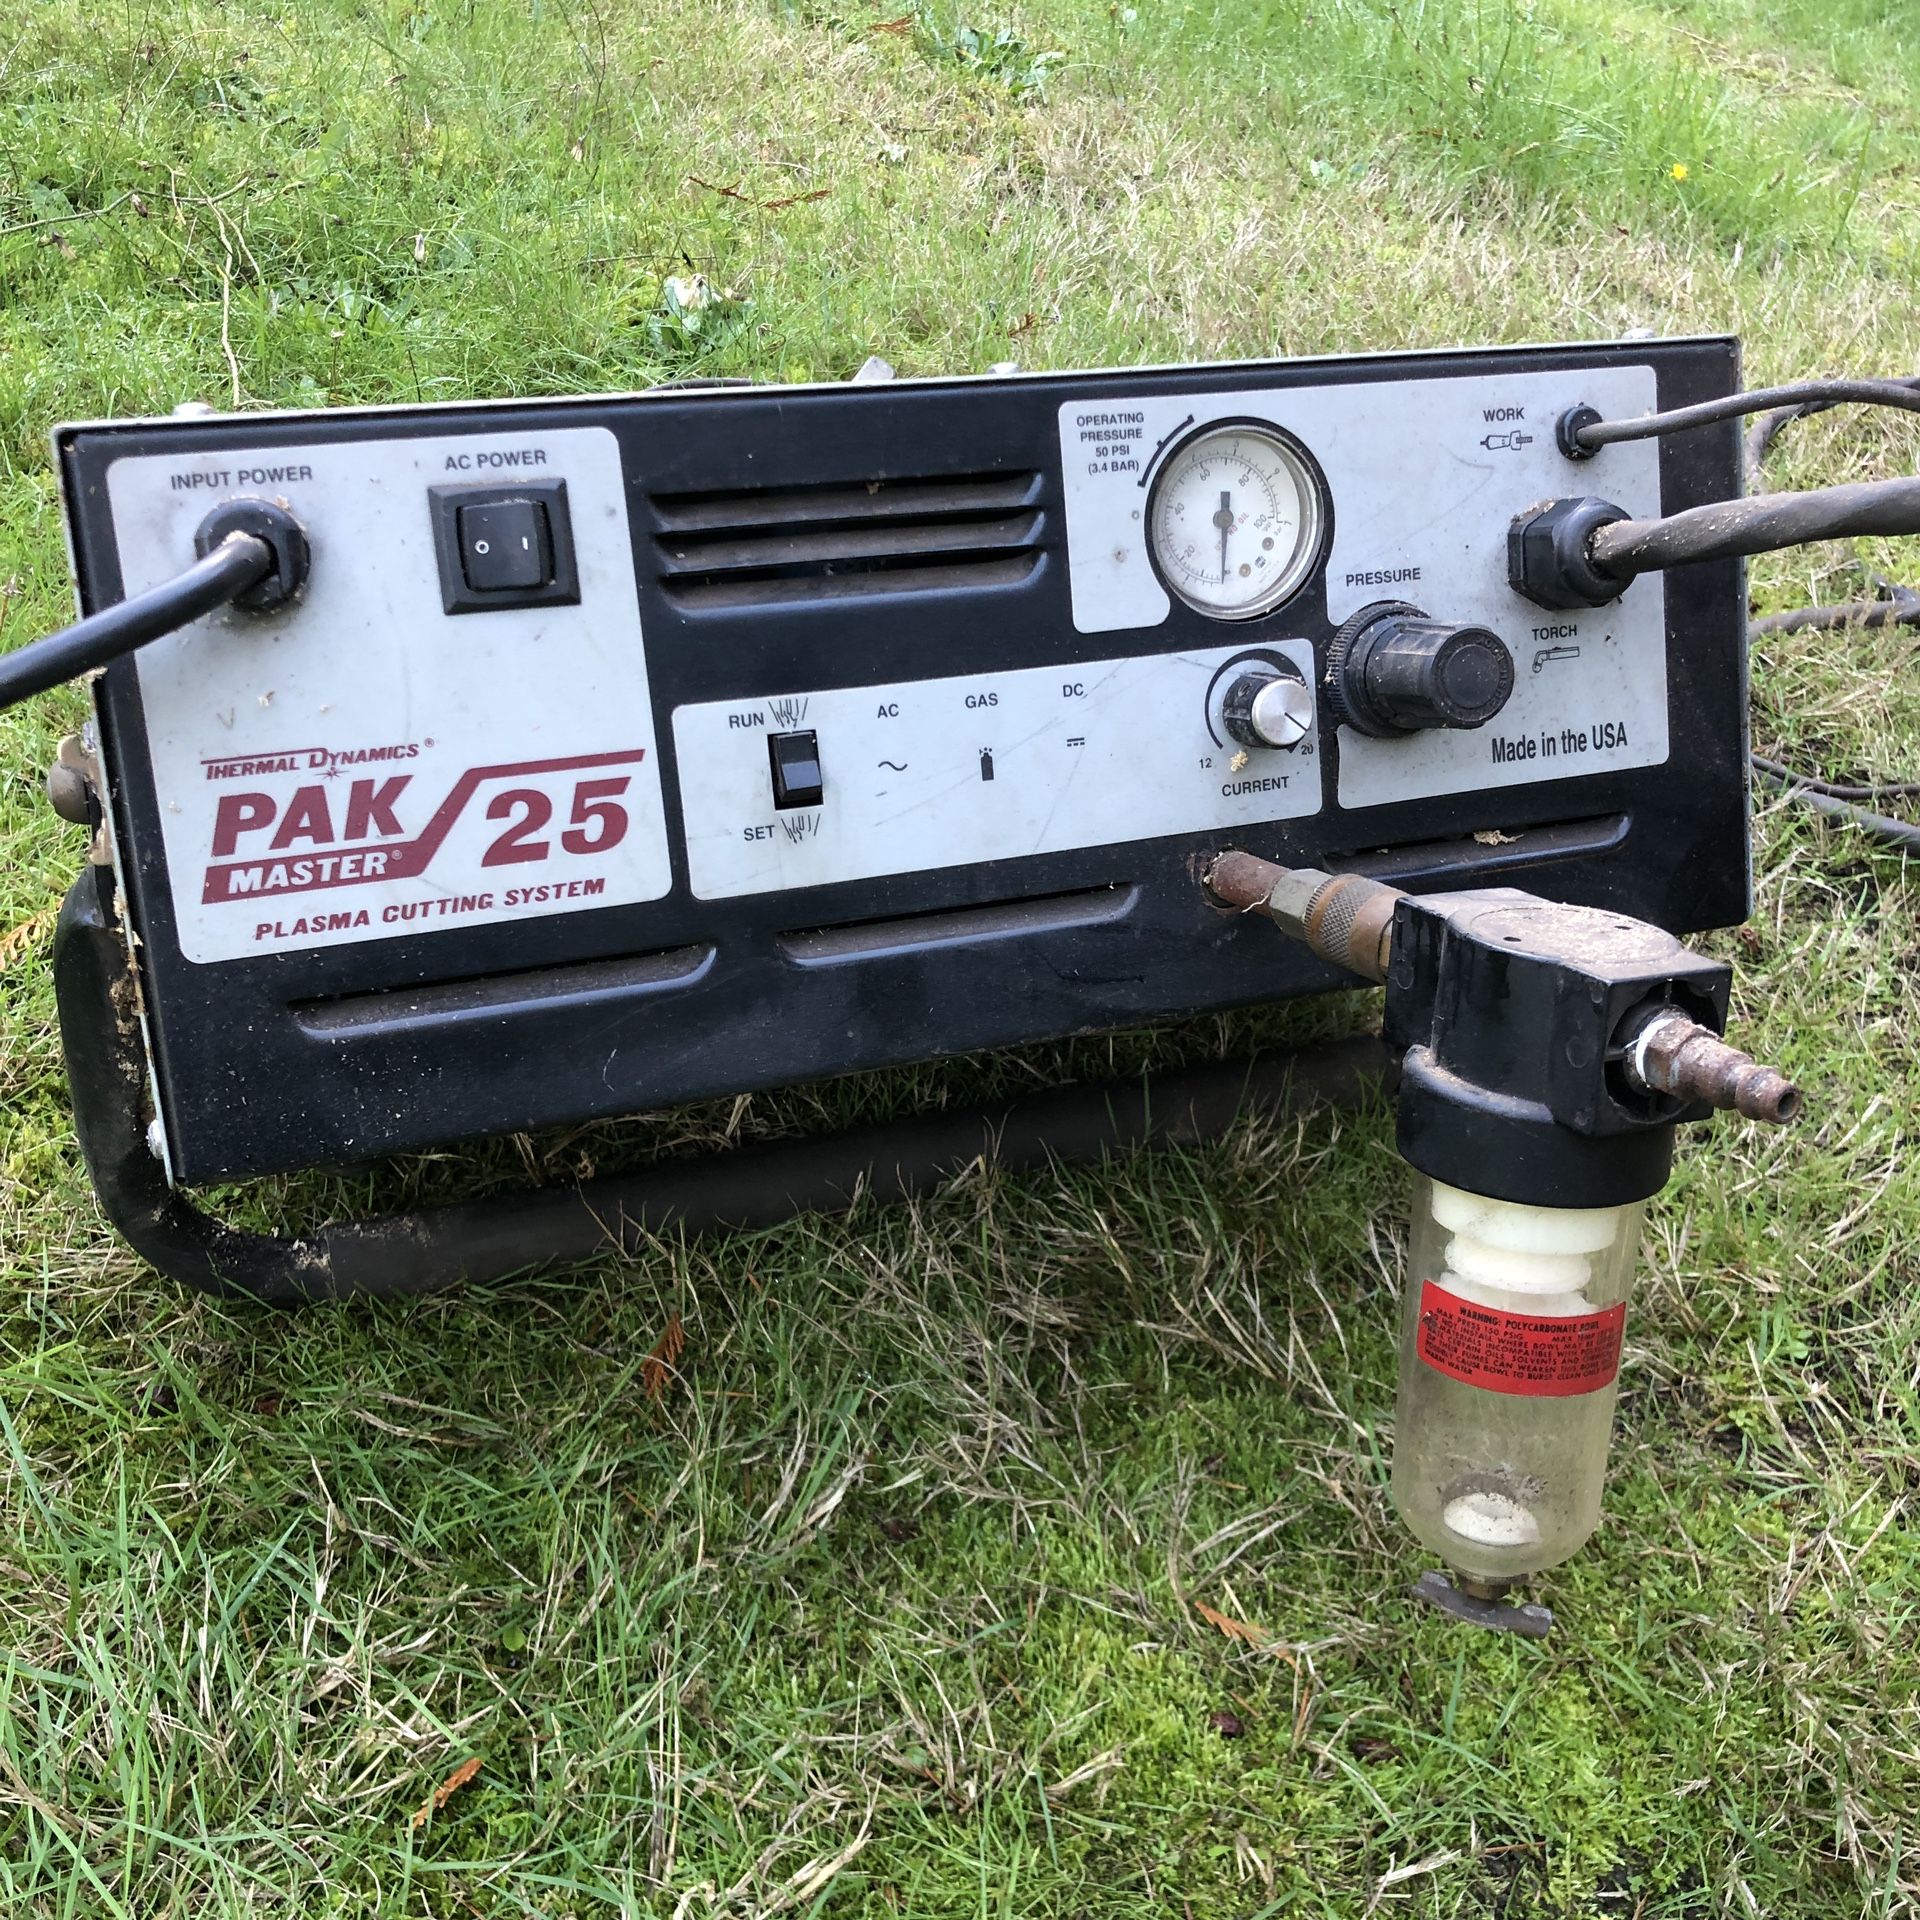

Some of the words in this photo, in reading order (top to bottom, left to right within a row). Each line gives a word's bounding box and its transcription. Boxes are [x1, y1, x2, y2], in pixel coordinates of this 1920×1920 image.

[1076, 412, 1144, 427] OPERATING
[1483, 407, 1525, 422] WORK
[1080, 428, 1143, 442] PRESSURE
[1095, 446, 1108, 457] 50
[1112, 445, 1130, 456] PSI
[444, 452, 472, 471] AC
[477, 449, 547, 467] POWER
[1088, 462, 1108, 476] (3.4
[1111, 460, 1140, 473] BAR)
[171, 471, 231, 490] INPUT
[239, 465, 313, 484] POWER
[1238, 474, 1250, 487] 80
[1253, 513, 1267, 529] 100
[1184, 544, 1195, 557] 20
[1345, 567, 1421, 587] PRESSURE
[1532, 624, 1577, 641] TORCH
[1063, 683, 1084, 698] DC
[965, 693, 999, 709] GAS
[877, 703, 900, 719] AC
[728, 713, 765, 729] RUN
[1301, 744, 1314, 755] 20
[1492, 734, 1537, 763] Made
[1541, 731, 1556, 752] in
[1562, 728, 1587, 750] the
[1592, 721, 1628, 751] USA
[203, 754, 300, 780] THERMAL
[309, 744, 419, 768] DYNAMICS
[1199, 758, 1212, 769] 12
[1222, 776, 1290, 797] CURRENT
[212, 775, 413, 857] PAK
[481, 776, 632, 868] 25
[743, 825, 776, 841] SET
[228, 852, 387, 894] MASTER
[255, 910, 371, 941] PLASMA
[382, 893, 494, 923] CUTTING
[505, 878, 605, 907] SYSTEM
[1505, 1319, 1577, 1333] POLYCARBONATE
